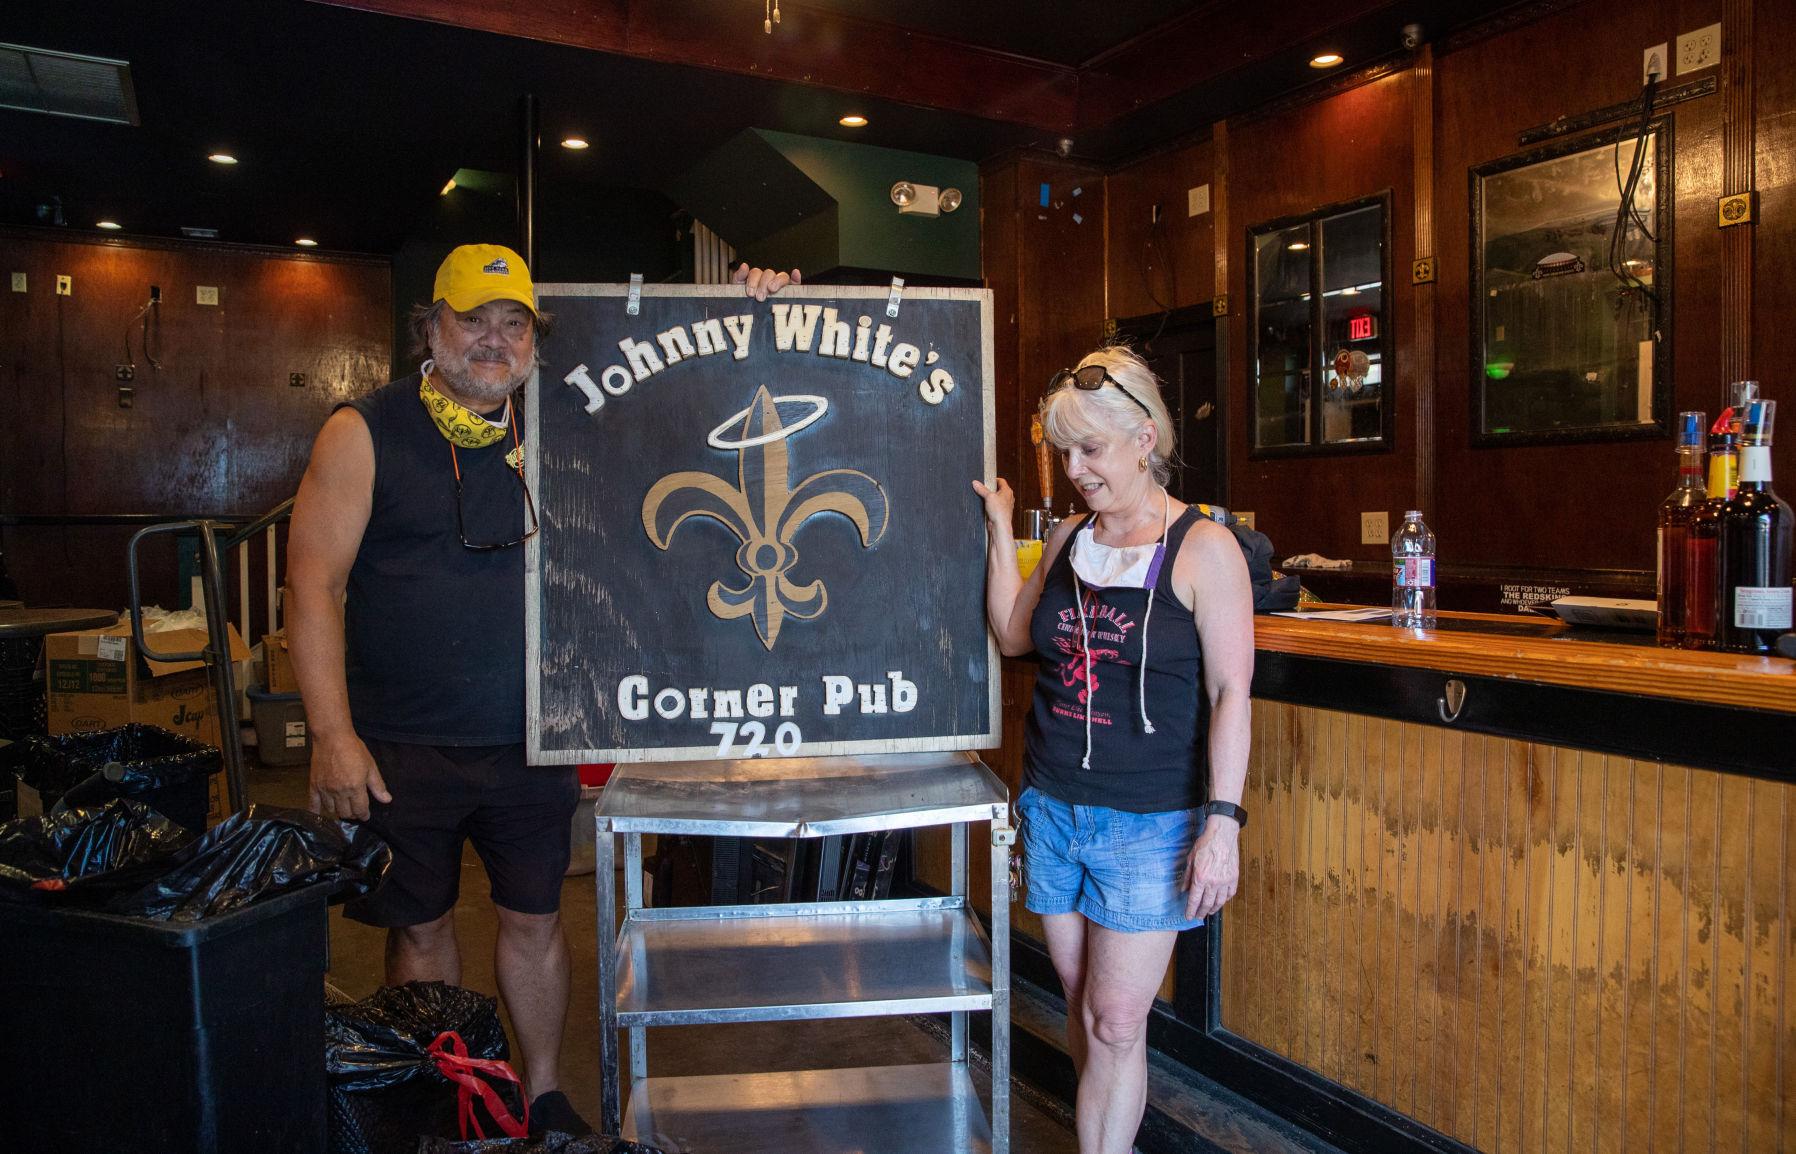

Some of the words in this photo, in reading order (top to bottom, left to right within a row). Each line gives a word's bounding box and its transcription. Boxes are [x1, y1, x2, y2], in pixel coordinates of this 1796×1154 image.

[564, 313, 754, 416] Johnny
[771, 304, 955, 406] White's
[1503, 591, 1520, 599] THE
[1504, 584, 1520, 592] ROOT
[1520, 585, 1532, 593] FOR
[1548, 586, 1570, 595] TEAMS
[1097, 631, 1126, 644] WHISKY
[617, 674, 798, 721] Corner
[822, 671, 918, 715] Pub
[1092, 717, 1113, 726] HELL
[709, 721, 802, 757] 720
